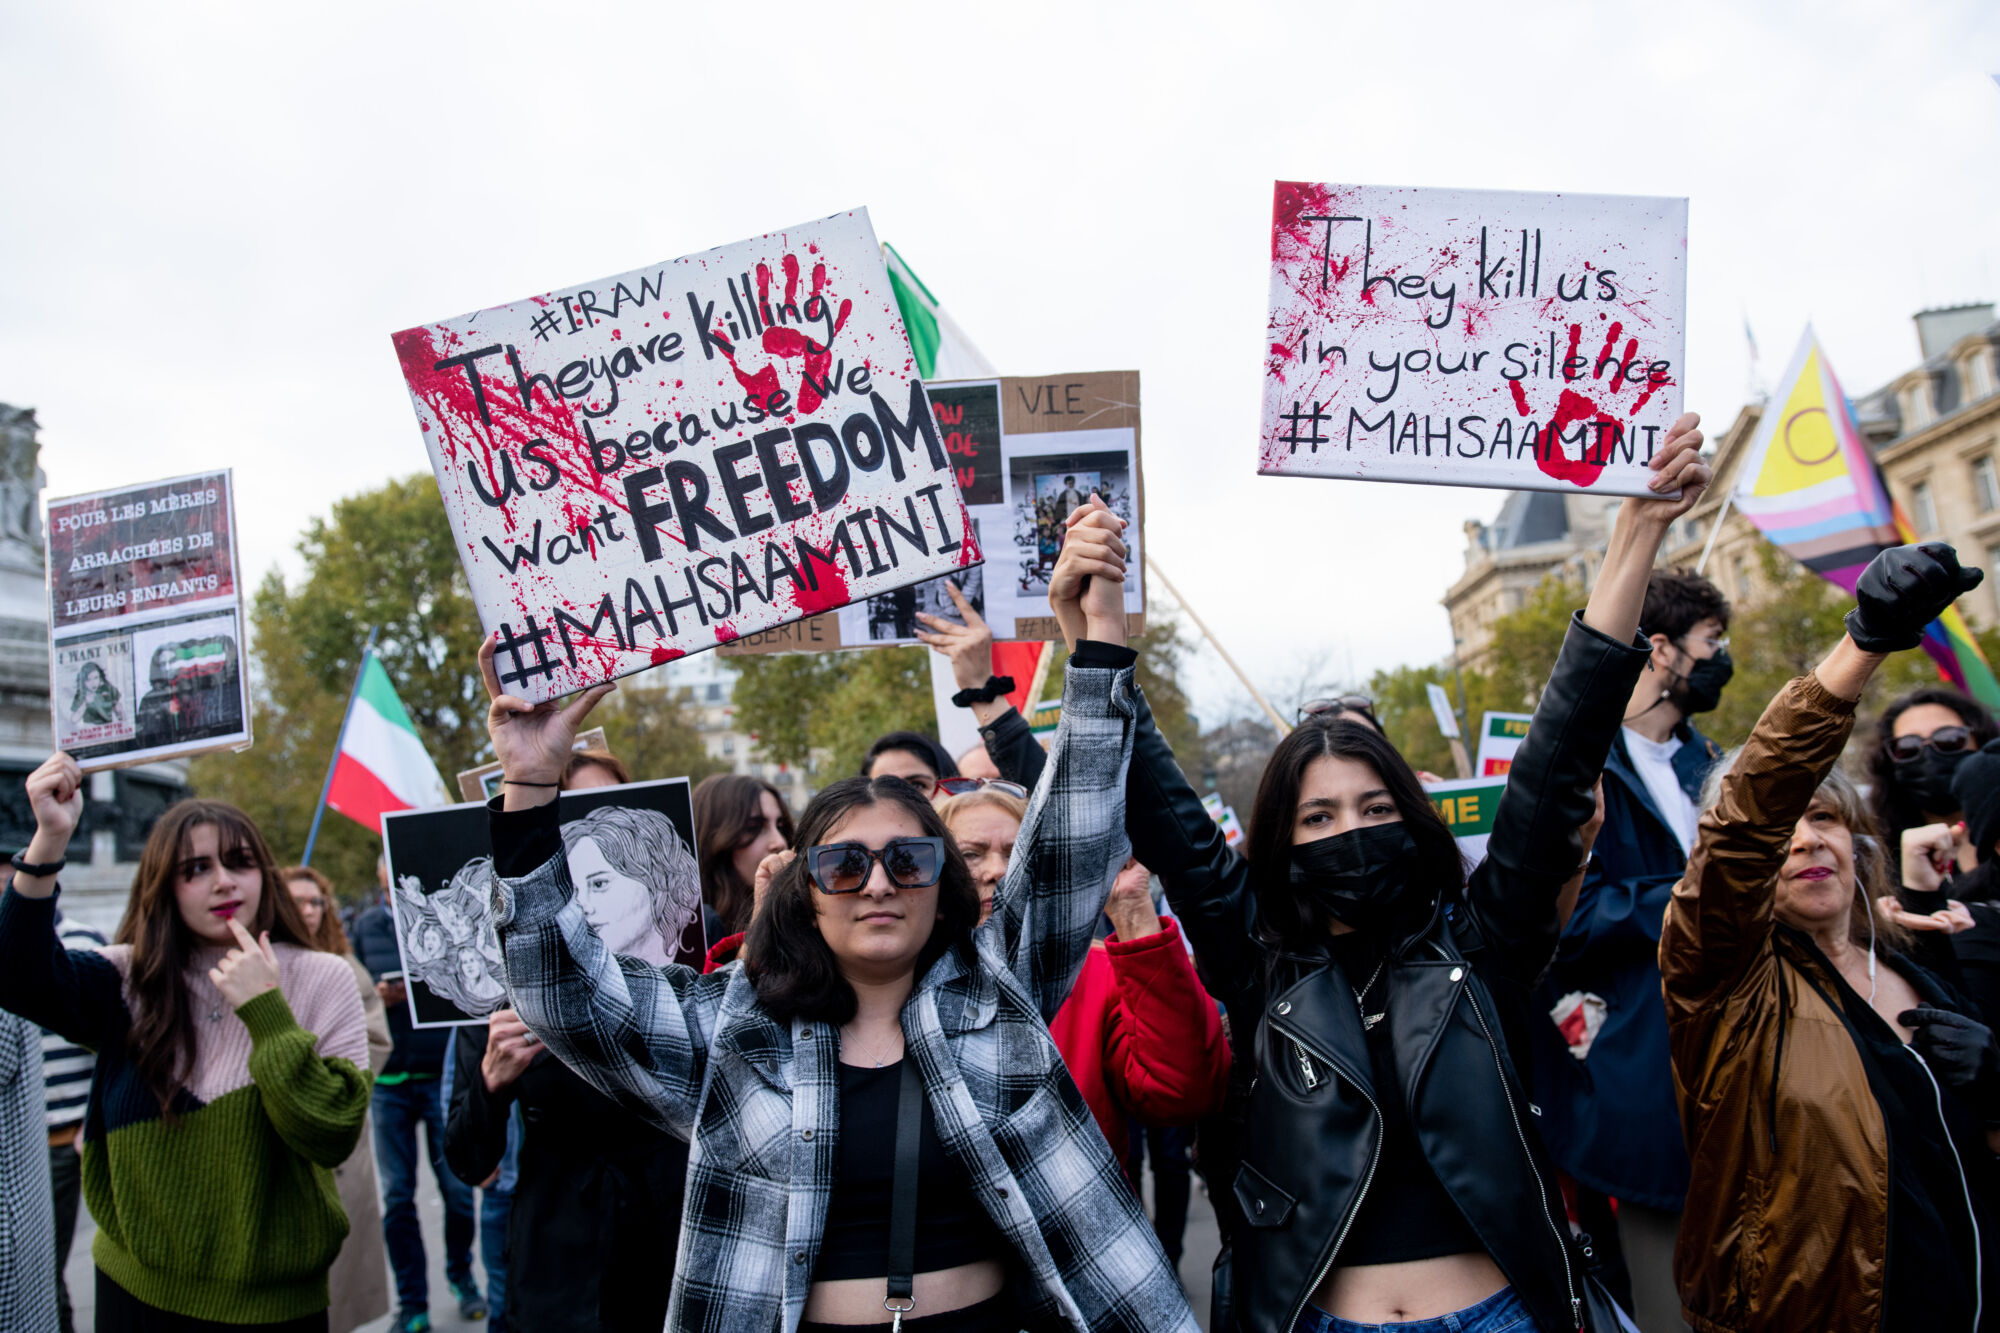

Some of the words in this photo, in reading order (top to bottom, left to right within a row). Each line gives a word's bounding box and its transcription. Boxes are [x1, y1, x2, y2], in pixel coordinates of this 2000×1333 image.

[530, 270, 664, 342] #IRAN
[1301, 215, 1456, 328] They
[1479, 225, 1541, 299] kill
[1557, 269, 1617, 302] us
[1018, 383, 1085, 415] VIE
[1301, 328, 1347, 366] in
[1366, 348, 1490, 403] your
[467, 438, 561, 508] us
[582, 388, 793, 475] because
[1278, 400, 1660, 467] #MAHSAAMINI
[622, 379, 948, 562] FREEDOM
[57, 510, 108, 532] POUR
[111, 502, 146, 522] LES
[150, 489, 217, 515] MÈRES
[68, 540, 183, 572] ARRACHÉES
[187, 531, 214, 550] DE
[494, 484, 961, 688] #MAHSAAMINI
[65, 591, 127, 616] LEURS
[131, 574, 218, 604] ENFANTS
[68, 647, 102, 662] WANT
[107, 640, 131, 656] YOU
